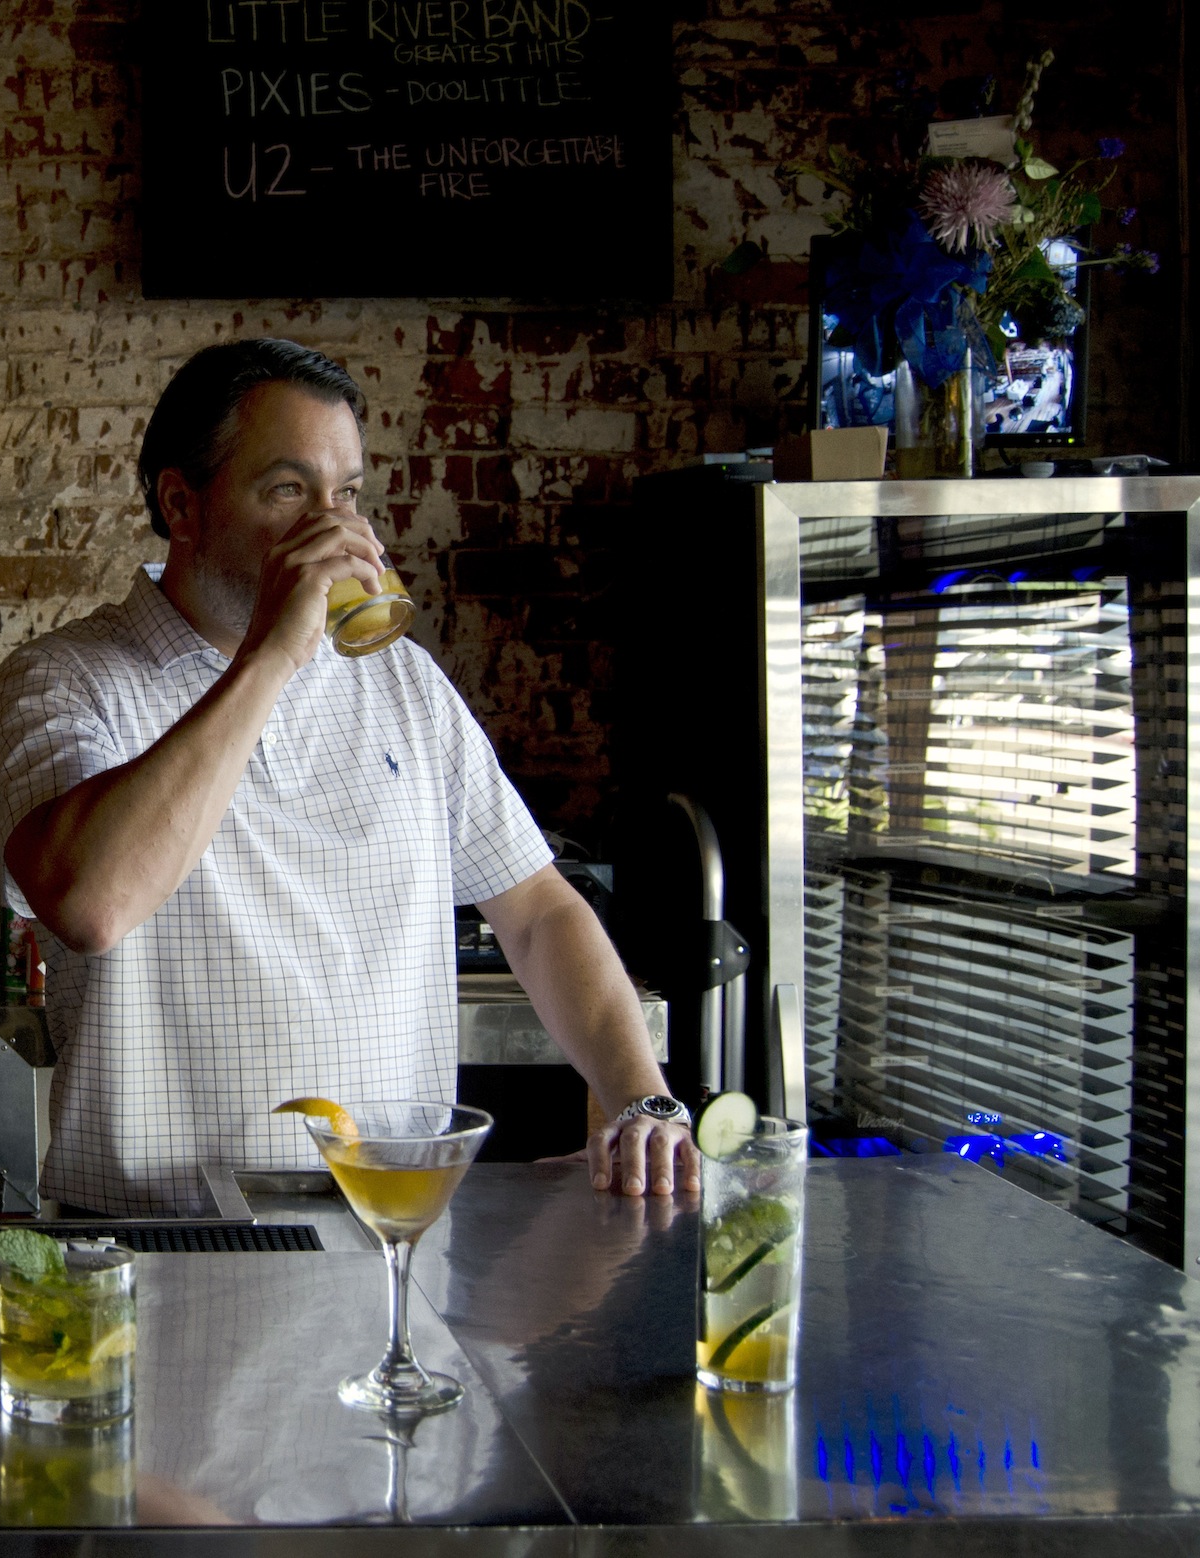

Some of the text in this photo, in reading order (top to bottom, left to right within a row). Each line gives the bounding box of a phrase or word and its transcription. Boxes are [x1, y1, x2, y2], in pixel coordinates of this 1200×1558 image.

[206, 0, 348, 42] LITTLE
[368, 0, 474, 43] RIVER
[394, 40, 585, 67] GREATEST HITS
[220, 68, 374, 117] PIXIES
[408, 71, 592, 106] DOOLITTLE
[223, 141, 307, 202] U2
[347, 143, 412, 171] THE
[425, 134, 627, 168] UNFORGETTABLE
[418, 172, 492, 200] FIRE
